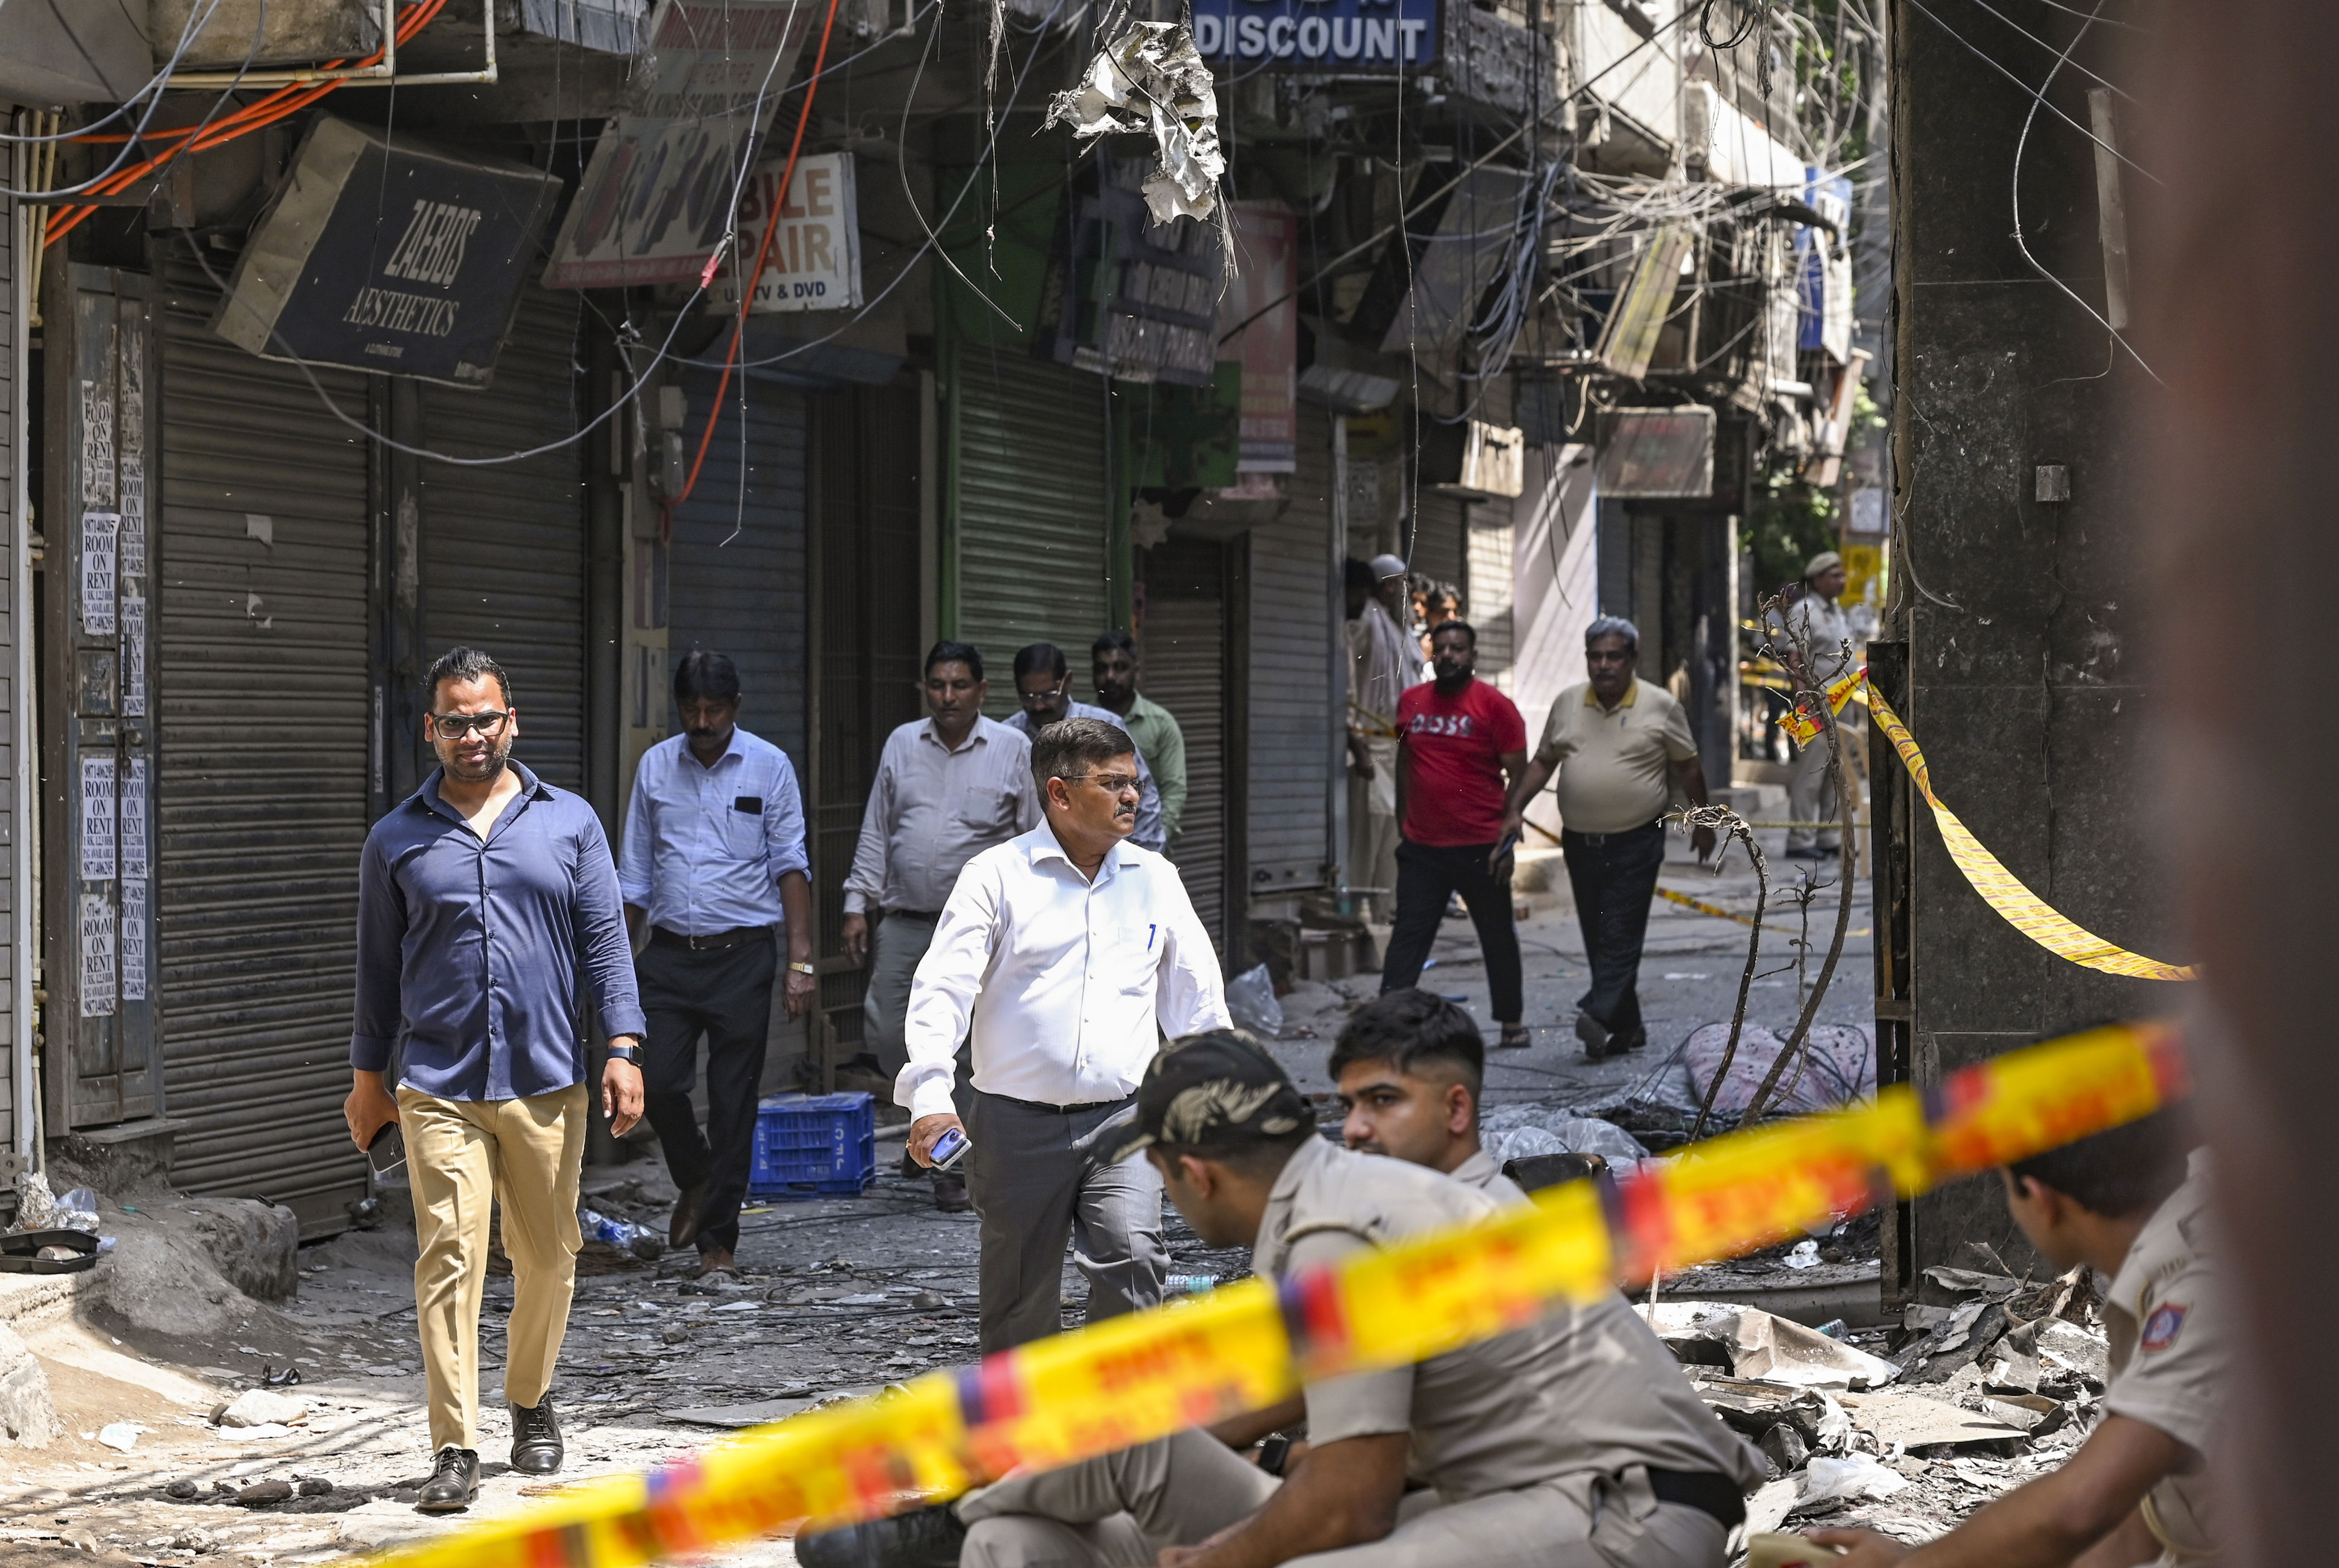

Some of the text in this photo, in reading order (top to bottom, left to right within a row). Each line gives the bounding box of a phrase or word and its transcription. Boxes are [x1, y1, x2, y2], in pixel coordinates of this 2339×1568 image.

[1195, 14, 1426, 60] DISCOUNT
[777, 284, 788, 299] &
[794, 281, 826, 298] DVD
[342, 286, 460, 337] AESTHETICS
[126, 497, 138, 514] ON
[121, 516, 141, 533] RENT
[85, 535, 113, 553] ROOM
[93, 554, 106, 571] ON
[86, 573, 112, 589] RENT
[85, 781, 113, 798] ROOM
[121, 781, 143, 798] ROOM
[93, 799, 106, 816] ON
[127, 800, 138, 816] ON
[86, 817, 112, 835] RENT
[122, 817, 142, 834] RENT
[122, 902, 144, 920] ROOM
[84, 918, 113, 936] ROOM
[127, 921, 139, 937] ON
[92, 937, 105, 955] ON
[123, 938, 142, 956] RENT
[86, 955, 112, 974] RENT
